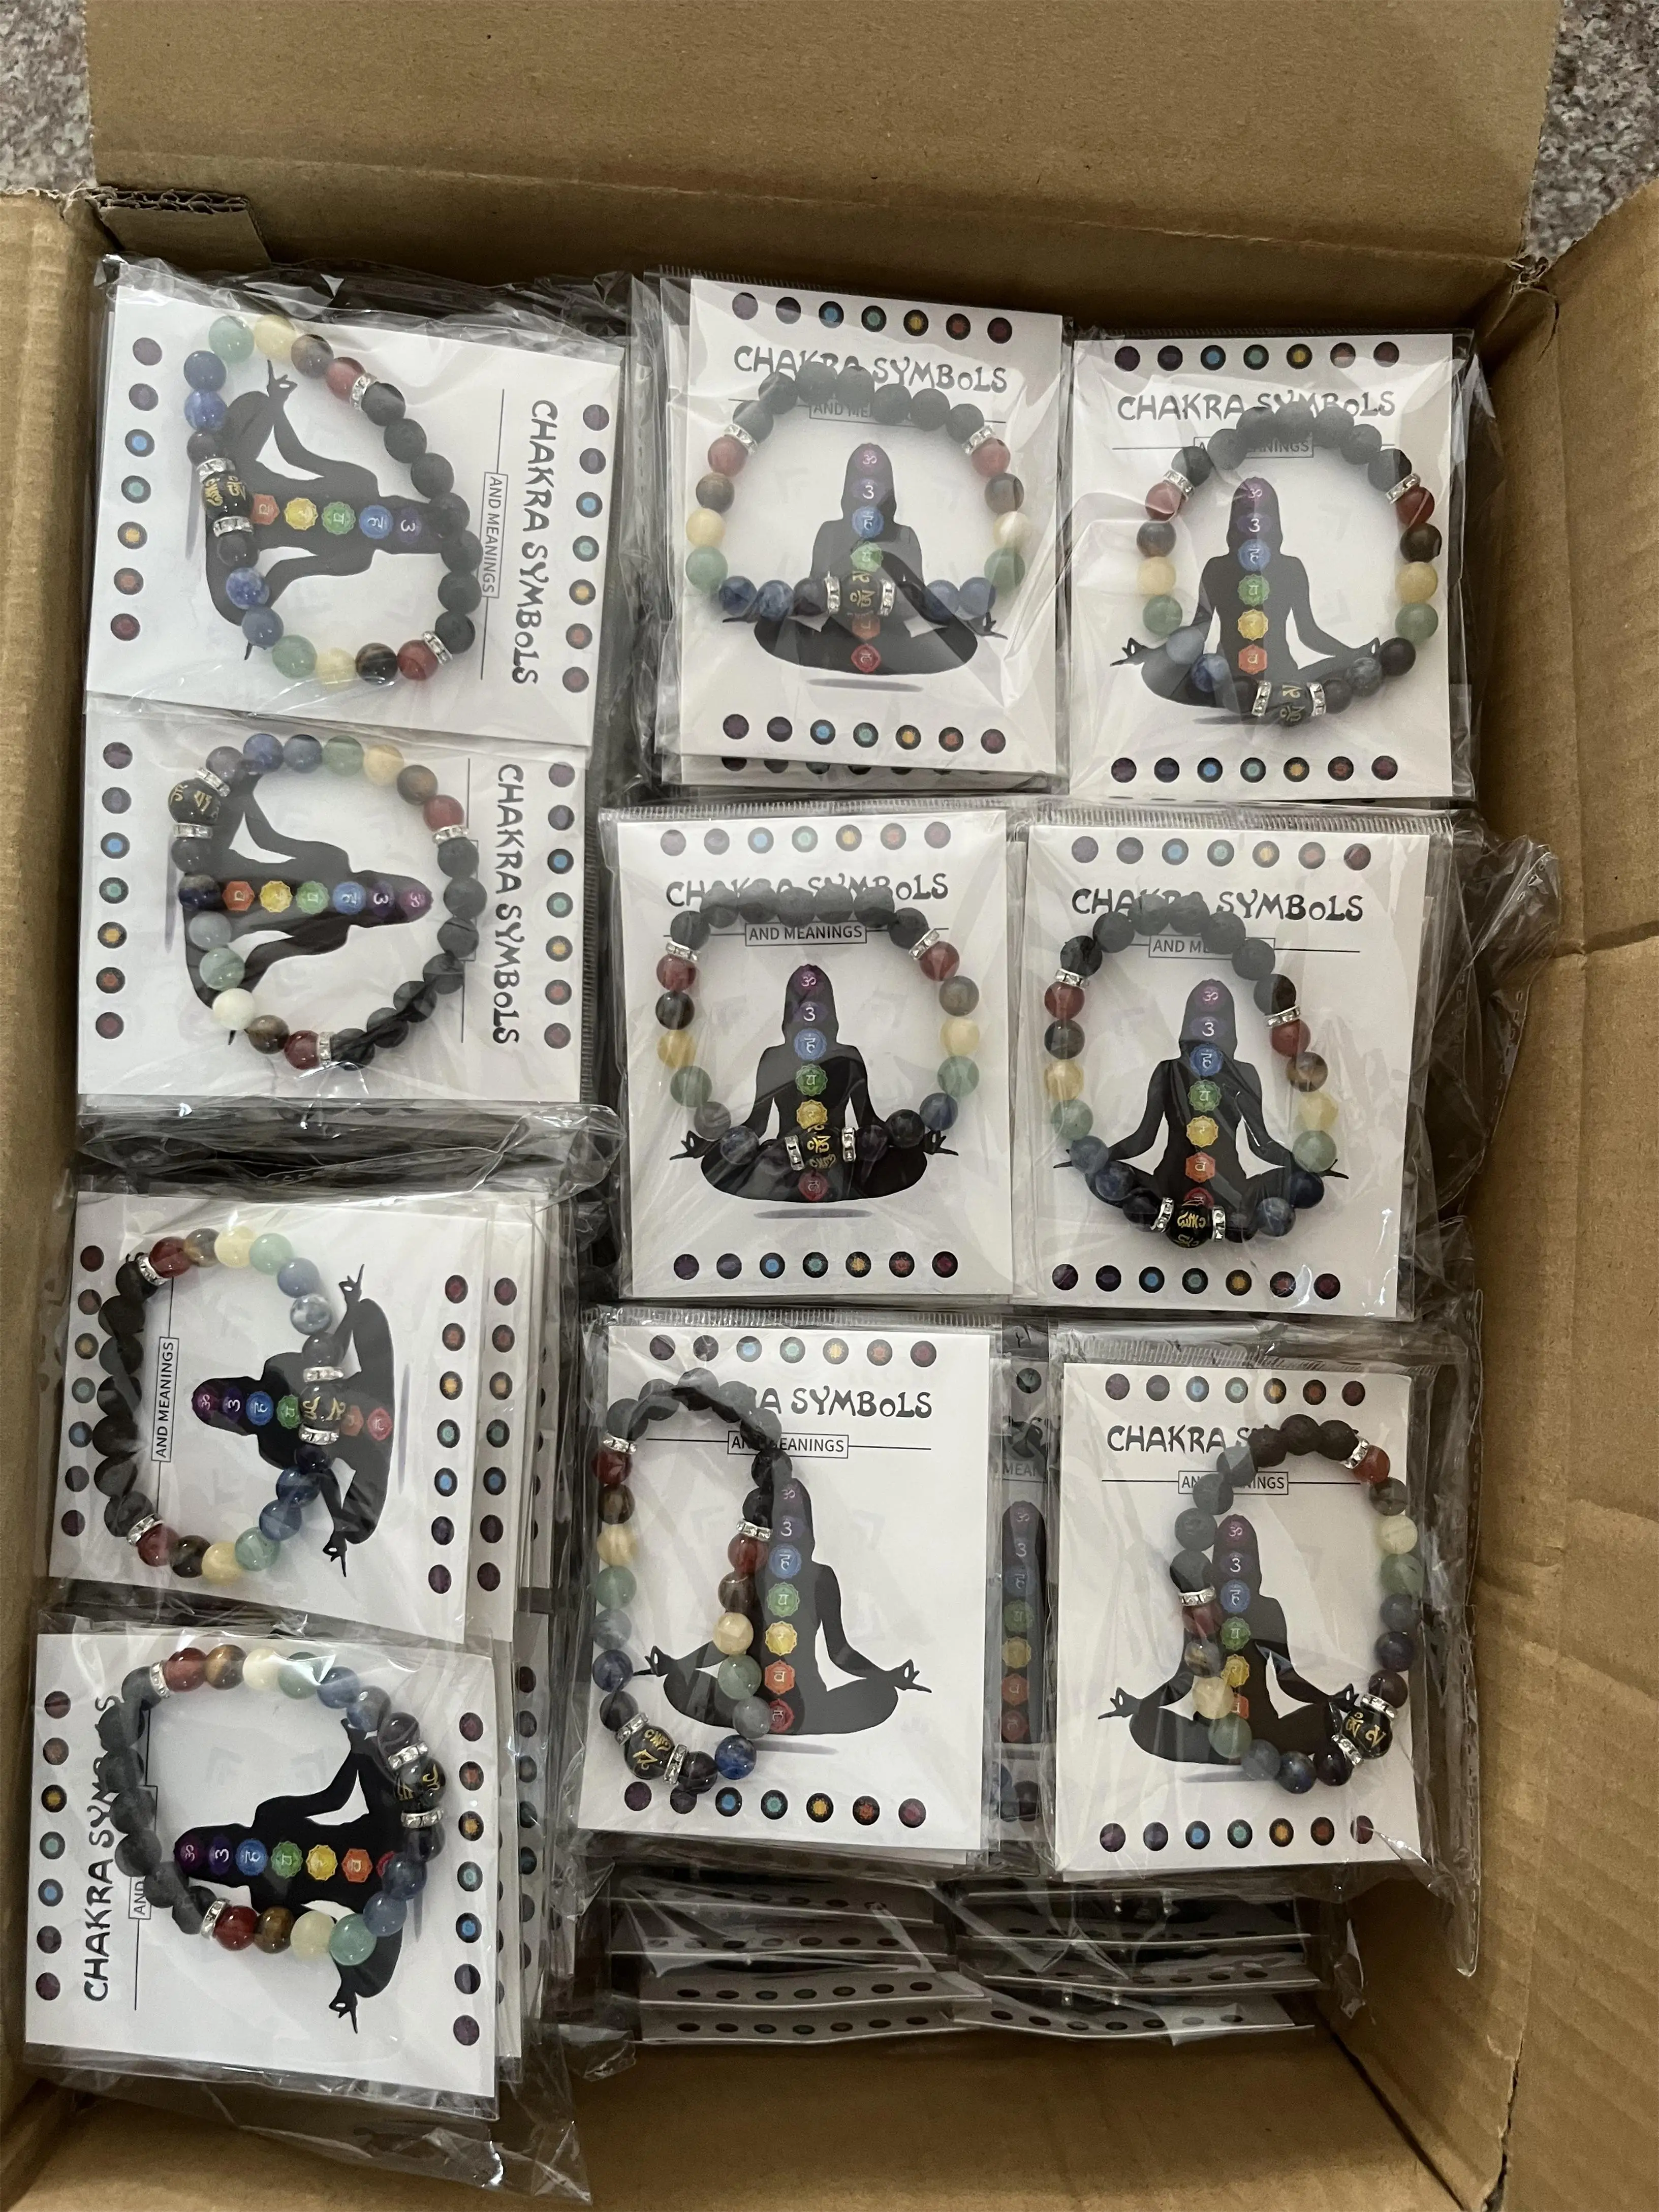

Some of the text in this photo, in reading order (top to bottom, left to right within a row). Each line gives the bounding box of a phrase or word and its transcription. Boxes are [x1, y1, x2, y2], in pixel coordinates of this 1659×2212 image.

[1117, 393, 1244, 421] CHAKRA
[522, 400, 558, 531] CHAKRA
[482, 476, 503, 594] AND MEANINGS
[495, 764, 525, 894] CHAKRA
[749, 925, 863, 941] AND MEANINGS
[1152, 939, 1185, 952] AND
[154, 1342, 174, 1459] AND MEANINGS
[777, 1437, 844, 1452] EANINGS
[1107, 1424, 1226, 1454] CHAKRA
[83, 1858, 113, 2002] CHAKRA
